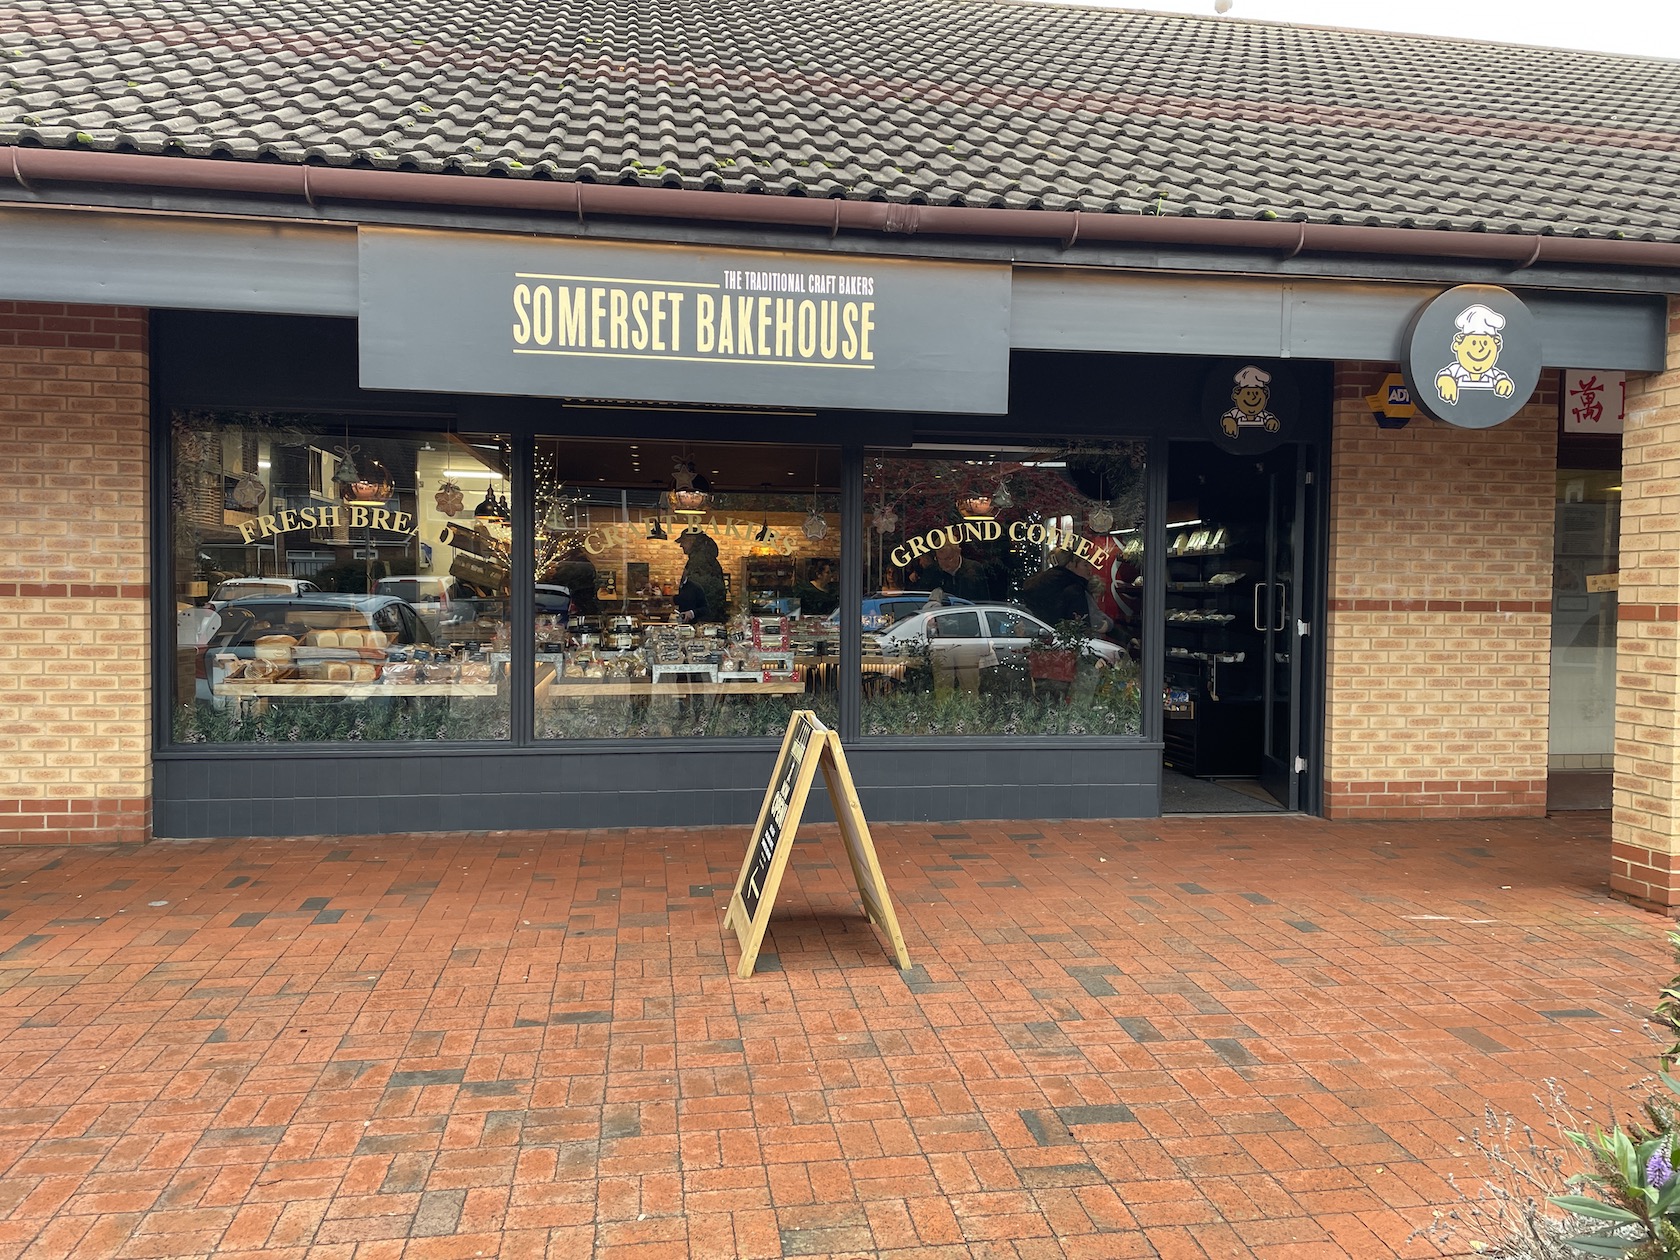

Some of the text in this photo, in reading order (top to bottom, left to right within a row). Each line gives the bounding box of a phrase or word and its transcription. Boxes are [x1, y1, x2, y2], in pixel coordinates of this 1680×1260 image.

[723, 270, 874, 296] THE TRADITIONAL CRAFT BAKERS
[512, 283, 875, 361] SOMERSET BAKEHOUSE
[1569, 375, 1604, 424] 萬
[236, 505, 342, 545] FRESH
[686, 514, 797, 556] BAKERS
[890, 520, 1110, 571] GROUND COFFEE
